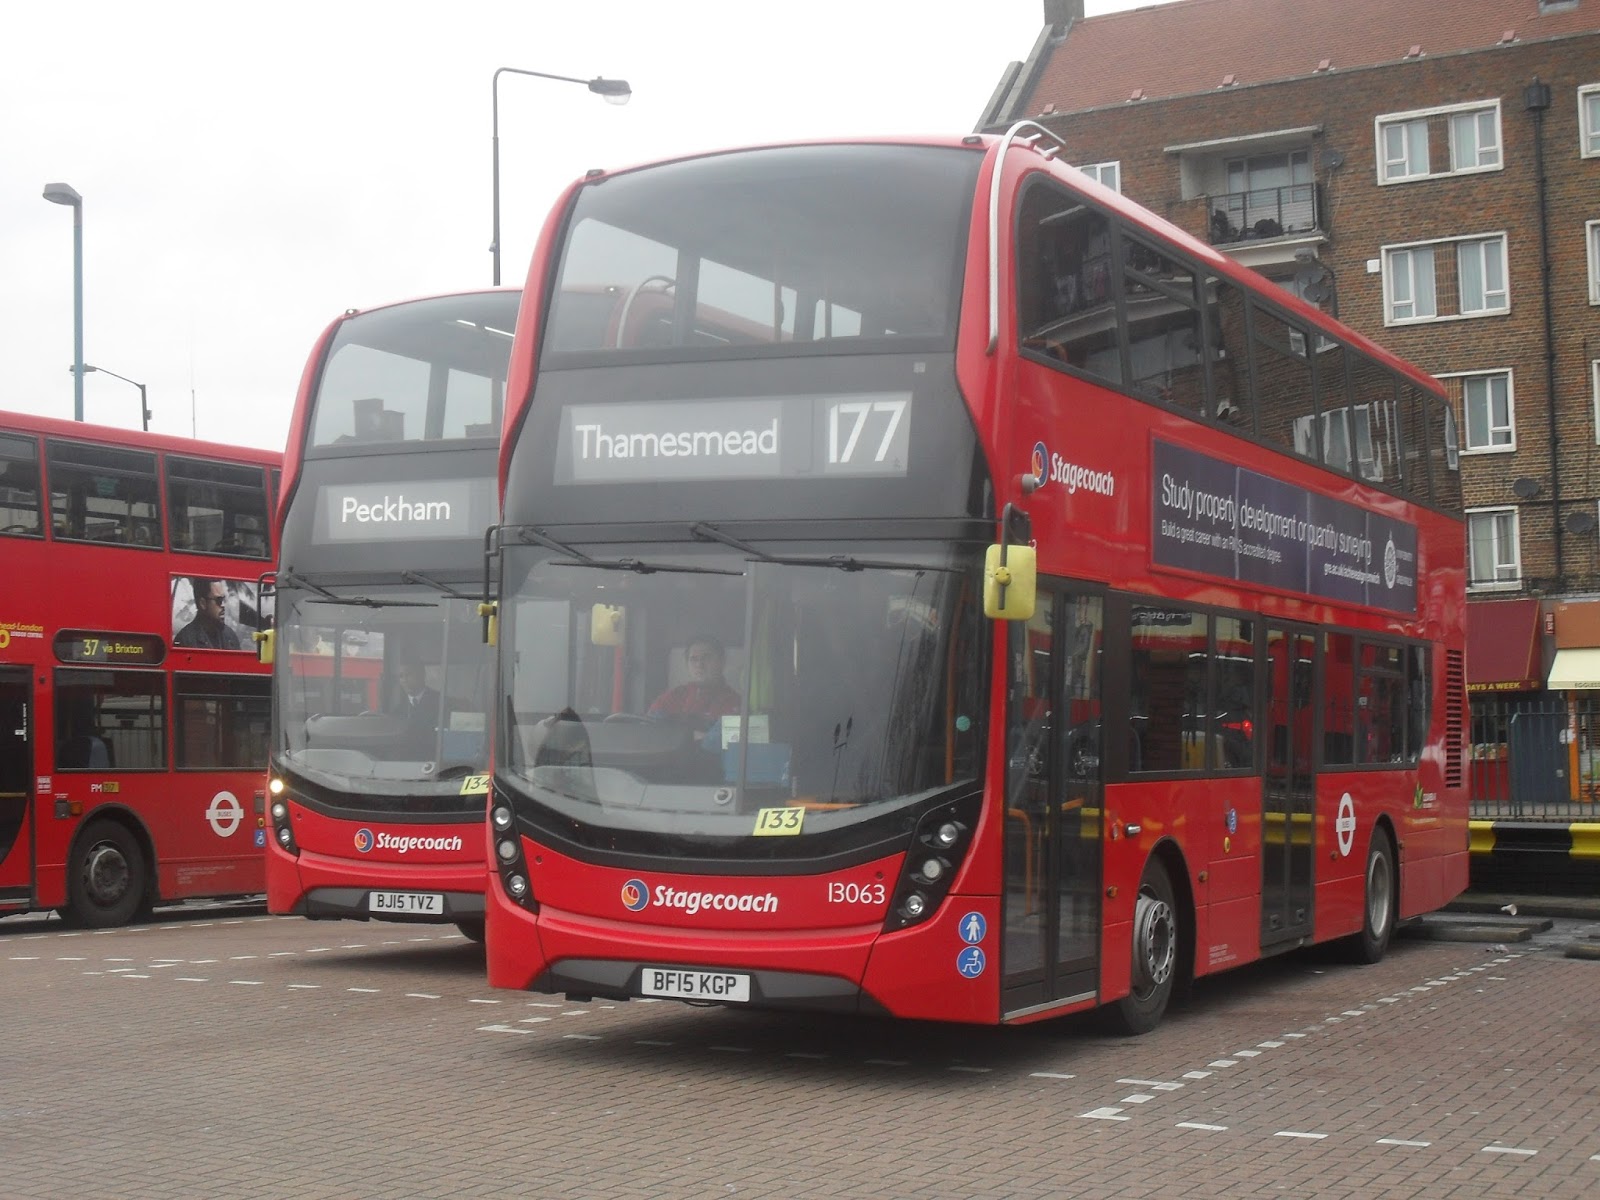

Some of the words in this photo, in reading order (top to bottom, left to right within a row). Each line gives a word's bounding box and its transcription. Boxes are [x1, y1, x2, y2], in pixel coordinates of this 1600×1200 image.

[575, 418, 778, 459] Thamesmead
[828, 400, 907, 463] 177
[1050, 452, 1115, 497] Stagecoach
[341, 495, 451, 523] Peckham
[1162, 473, 1194, 519] Study
[1196, 491, 1237, 530] property
[1240, 498, 1297, 540] development
[1298, 521, 1307, 542] or
[1308, 523, 1339, 557] quantity
[1339, 532, 1372, 566] surveying
[1161, 519, 1176, 538] Build
[1176, 526, 1181, 539] a
[1181, 527, 1196, 544] great
[1195, 531, 1211, 546] career
[1211, 532, 1222, 548] with
[83, 639, 100, 656] 37
[102, 643, 113, 654] via
[115, 642, 144, 655] Brixton
[1466, 683, 1487, 691] DAYS
[1488, 682, 1495, 690] A
[1496, 681, 1521, 690] WEEK
[90, 783, 103, 793] PM
[760, 809, 802, 829] 133
[376, 832, 463, 854] Stagecoach
[377, 894, 405, 909] BJ15
[408, 895, 434, 910] TVZ
[652, 885, 779, 915] Stagecoach
[828, 882, 886, 905] 13063
[653, 971, 694, 993] BF15
[699, 974, 737, 995] KGP
